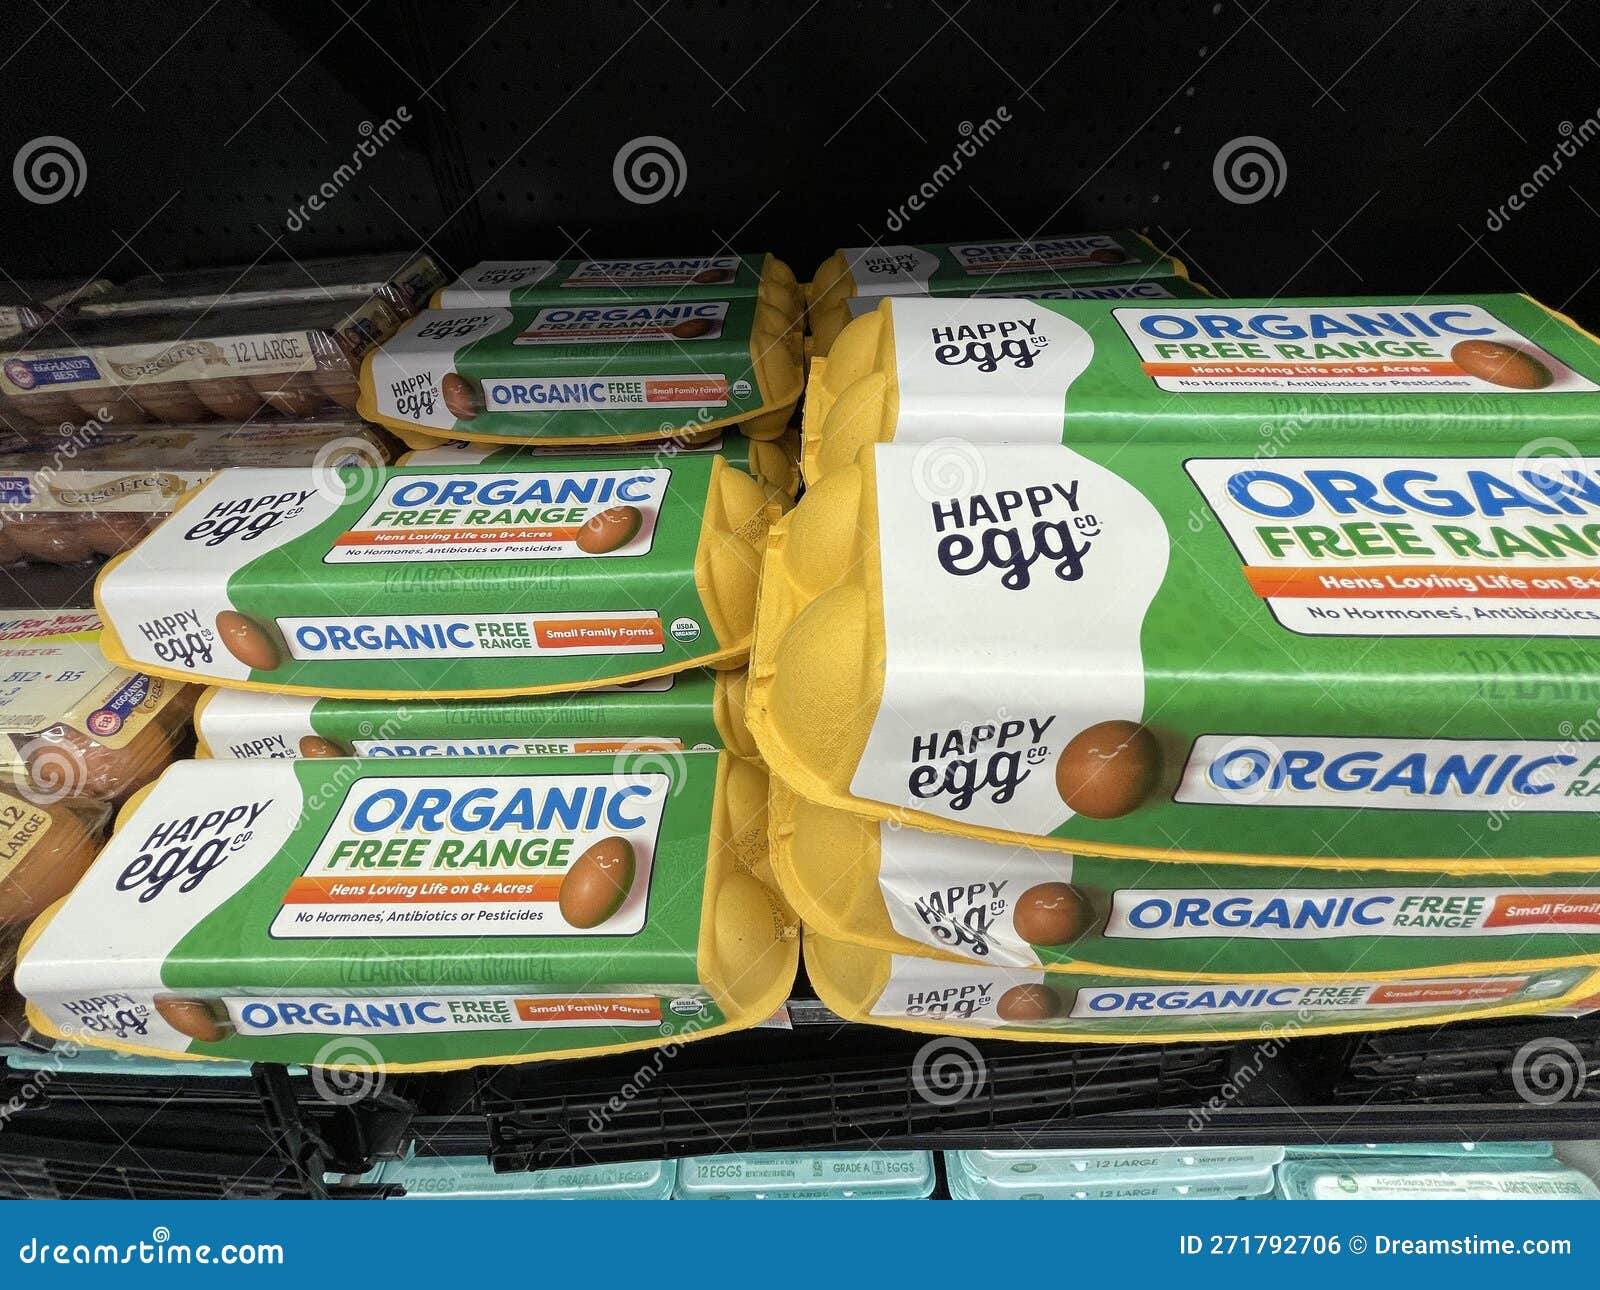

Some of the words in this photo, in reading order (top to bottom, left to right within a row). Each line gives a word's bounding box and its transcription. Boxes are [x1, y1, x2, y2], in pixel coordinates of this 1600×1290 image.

[961, 237, 1110, 256] ORGANIC
[586, 259, 733, 272] ORGANIC
[429, 314, 495, 329] HAPPY
[545, 305, 721, 322] ORGANIC
[537, 321, 589, 331] FREE
[932, 318, 1037, 344] HAPPY
[1139, 311, 1496, 341] ORGANIC
[231, 342, 250, 363] 12
[251, 338, 303, 361] LARGE
[935, 338, 1044, 372] egg
[1157, 342, 1272, 359] FREE
[1275, 341, 1443, 359] RANGE
[53, 370, 80, 380] BEST
[1191, 366, 1232, 376] Hens
[1233, 366, 1293, 377] Loving
[1295, 365, 1328, 375] Life
[1332, 367, 1354, 375] on
[1356, 365, 1379, 375] 8+
[1382, 364, 1431, 375] Acres
[391, 372, 432, 399] HAPPY
[491, 383, 607, 406] ORGANIC
[607, 382, 641, 395] FREE
[652, 387, 673, 396] Small
[675, 386, 699, 397] Family
[700, 386, 723, 395] Farms
[1180, 380, 1198, 388] No
[1286, 379, 1368, 388] Antibiotics
[1389, 378, 1470, 388] Pesticides
[396, 390, 437, 420] egg
[609, 394, 643, 404] RANGE
[392, 476, 655, 507] ORGANIC
[1226, 469, 1600, 517] ORGAN
[203, 489, 319, 520] HAPPY
[932, 480, 1080, 532] HAPPY
[184, 510, 289, 547] egg
[371, 508, 454, 528] FREE
[464, 507, 586, 526] RANGE
[374, 533, 406, 542] Hens
[408, 532, 450, 543] Loving
[454, 531, 477, 541] Life
[479, 532, 497, 540] on
[499, 530, 516, 540] 8+
[517, 530, 552, 539] Acres
[1255, 522, 1436, 558] FREE
[345, 549, 362, 557] No
[426, 545, 488, 555] Antibiotics
[505, 543, 563, 553] Pesticides
[937, 520, 1092, 591] egg
[1319, 575, 1384, 591] Hens
[1390, 574, 1478, 592] Loving
[1481, 574, 1527, 590] Life
[1531, 579, 1563, 590] on
[138, 609, 204, 642] HAPPY
[1307, 606, 1338, 620] No
[1474, 606, 1600, 621] Antibiotics
[296, 623, 475, 651] ORGANIC
[475, 622, 528, 638] FREE
[480, 638, 532, 649] RANGE
[546, 629, 578, 638] Small
[580, 628, 617, 641] Family
[619, 627, 654, 637] Farms
[154, 631, 214, 668] egg
[56, 671, 86, 682] B5
[229, 735, 287, 759] HAPPY
[912, 715, 1056, 763] HAPPY
[909, 751, 1031, 811] egg
[1208, 750, 1578, 796] ORGANIC
[352, 786, 652, 833] ORGANIC
[1, 813, 47, 861] LARGE
[139, 799, 275, 852] HAPPY
[327, 839, 426, 868] FREE
[433, 839, 575, 868] RANGE
[115, 833, 232, 904] egg
[329, 883, 366, 896] Hens
[368, 882, 418, 899] Loving
[421, 881, 448, 895] Life
[451, 885, 470, 895] on
[472, 882, 491, 895] 8+
[492, 881, 533, 895] Acres
[914, 879, 1009, 925] HAPPY
[296, 911, 314, 922] No
[387, 909, 458, 922] Antibiotics
[461, 912, 475, 922] or
[477, 909, 543, 921] Pesticides
[1128, 896, 1395, 929] ORGANIC
[1393, 896, 1485, 915] FREE
[1505, 904, 1551, 917] Small
[1393, 915, 1478, 929] RANGE
[62, 990, 137, 1015] HAPPY
[907, 983, 994, 1005] HAPPY
[1088, 988, 1301, 1012] ORGANIC
[1304, 986, 1370, 997] FREE
[1298, 997, 1362, 1006] RANGE
[241, 1001, 446, 1028] ORGANIC
[446, 1000, 508, 1013] FREE
[529, 1005, 563, 1013] Small
[566, 1004, 608, 1014] Family
[612, 1005, 650, 1015] Farms
[452, 1013, 512, 1024] RANGE
[697, 1164, 709, 1178] 12
[710, 1163, 742, 1177] EGGS
[833, 1162, 862, 1173] GRADE
[887, 1161, 914, 1173] EGGS
[1096, 1159, 1110, 1169] 12
[1113, 1158, 1160, 1168] LARGE
[418, 1178, 455, 1193] EGGS
[1100, 1189, 1113, 1198] 12
[1115, 1188, 1159, 1198] LARGE
